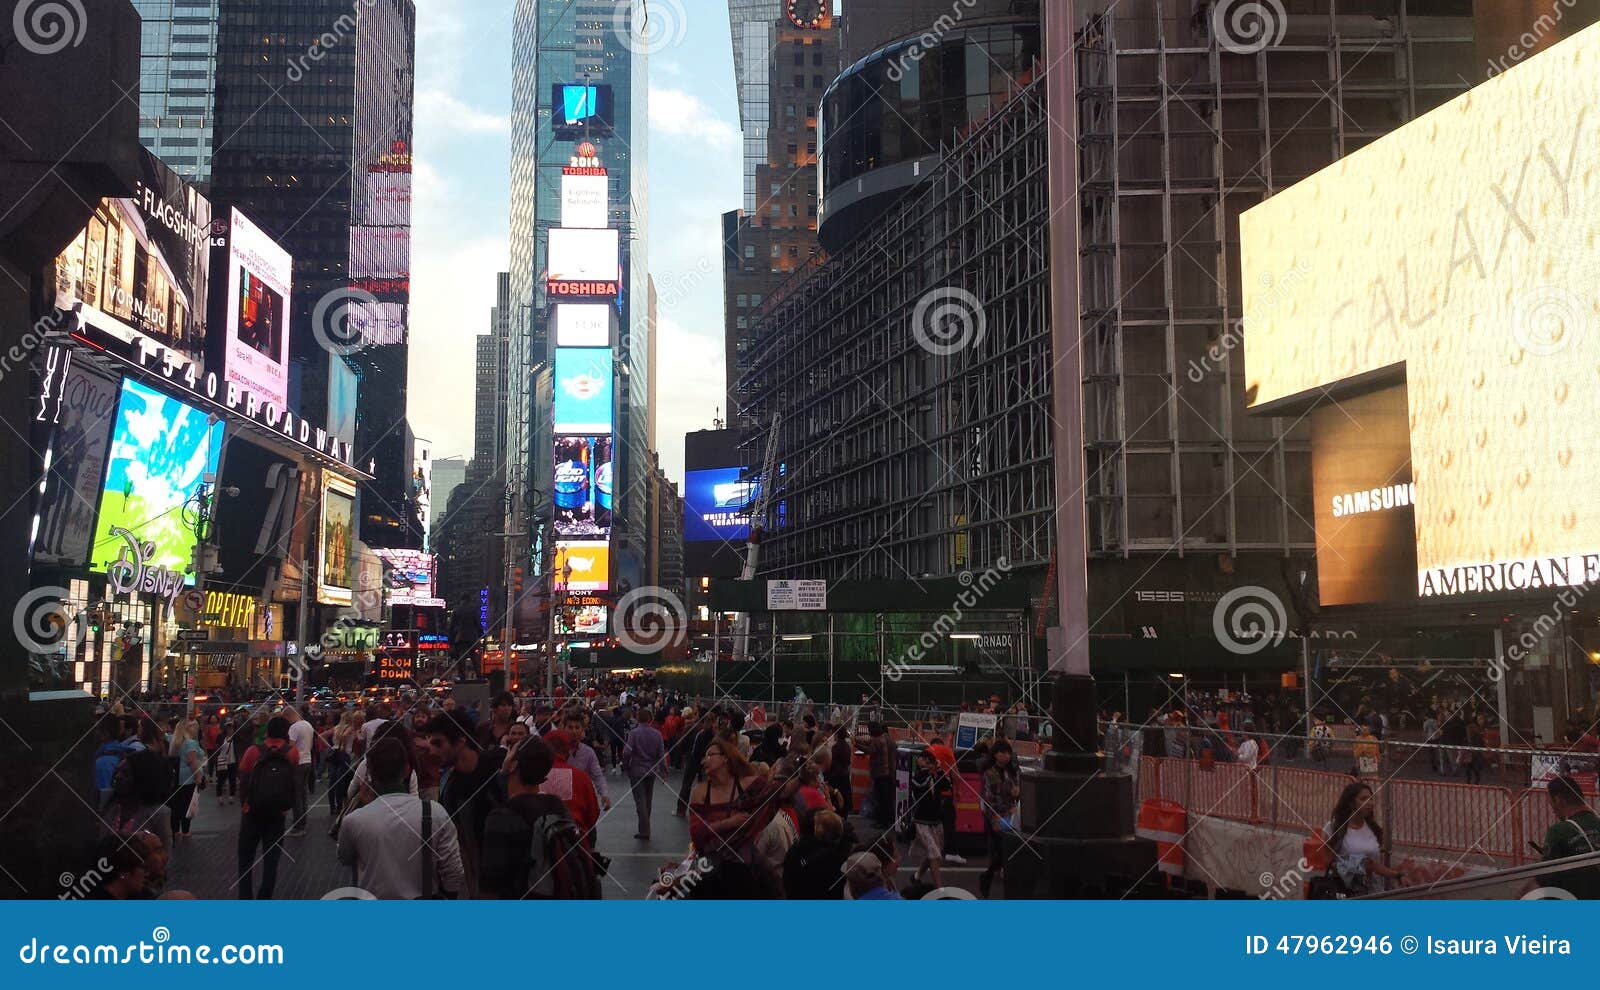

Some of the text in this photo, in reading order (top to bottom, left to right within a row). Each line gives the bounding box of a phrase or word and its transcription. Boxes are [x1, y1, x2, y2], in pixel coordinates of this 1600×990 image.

[570, 156, 600, 168] 2014
[563, 167, 607, 176] TOSHIBA
[144, 187, 203, 251] FLAGSHIPS
[210, 237, 226, 247] LG
[1330, 105, 1587, 376] GALAXY
[549, 282, 617, 294] TOSHIBA
[108, 283, 166, 328] VORNADO
[139, 337, 218, 399] 1540
[226, 381, 353, 464] BROADWAY
[703, 513, 727, 521] WHITE
[1419, 556, 1570, 598] AMERICAN
[1135, 591, 1184, 602] 1535
[200, 590, 254, 628] OREVER
[381, 658, 412, 667] SLOW
[381, 669, 411, 678] DOWN
